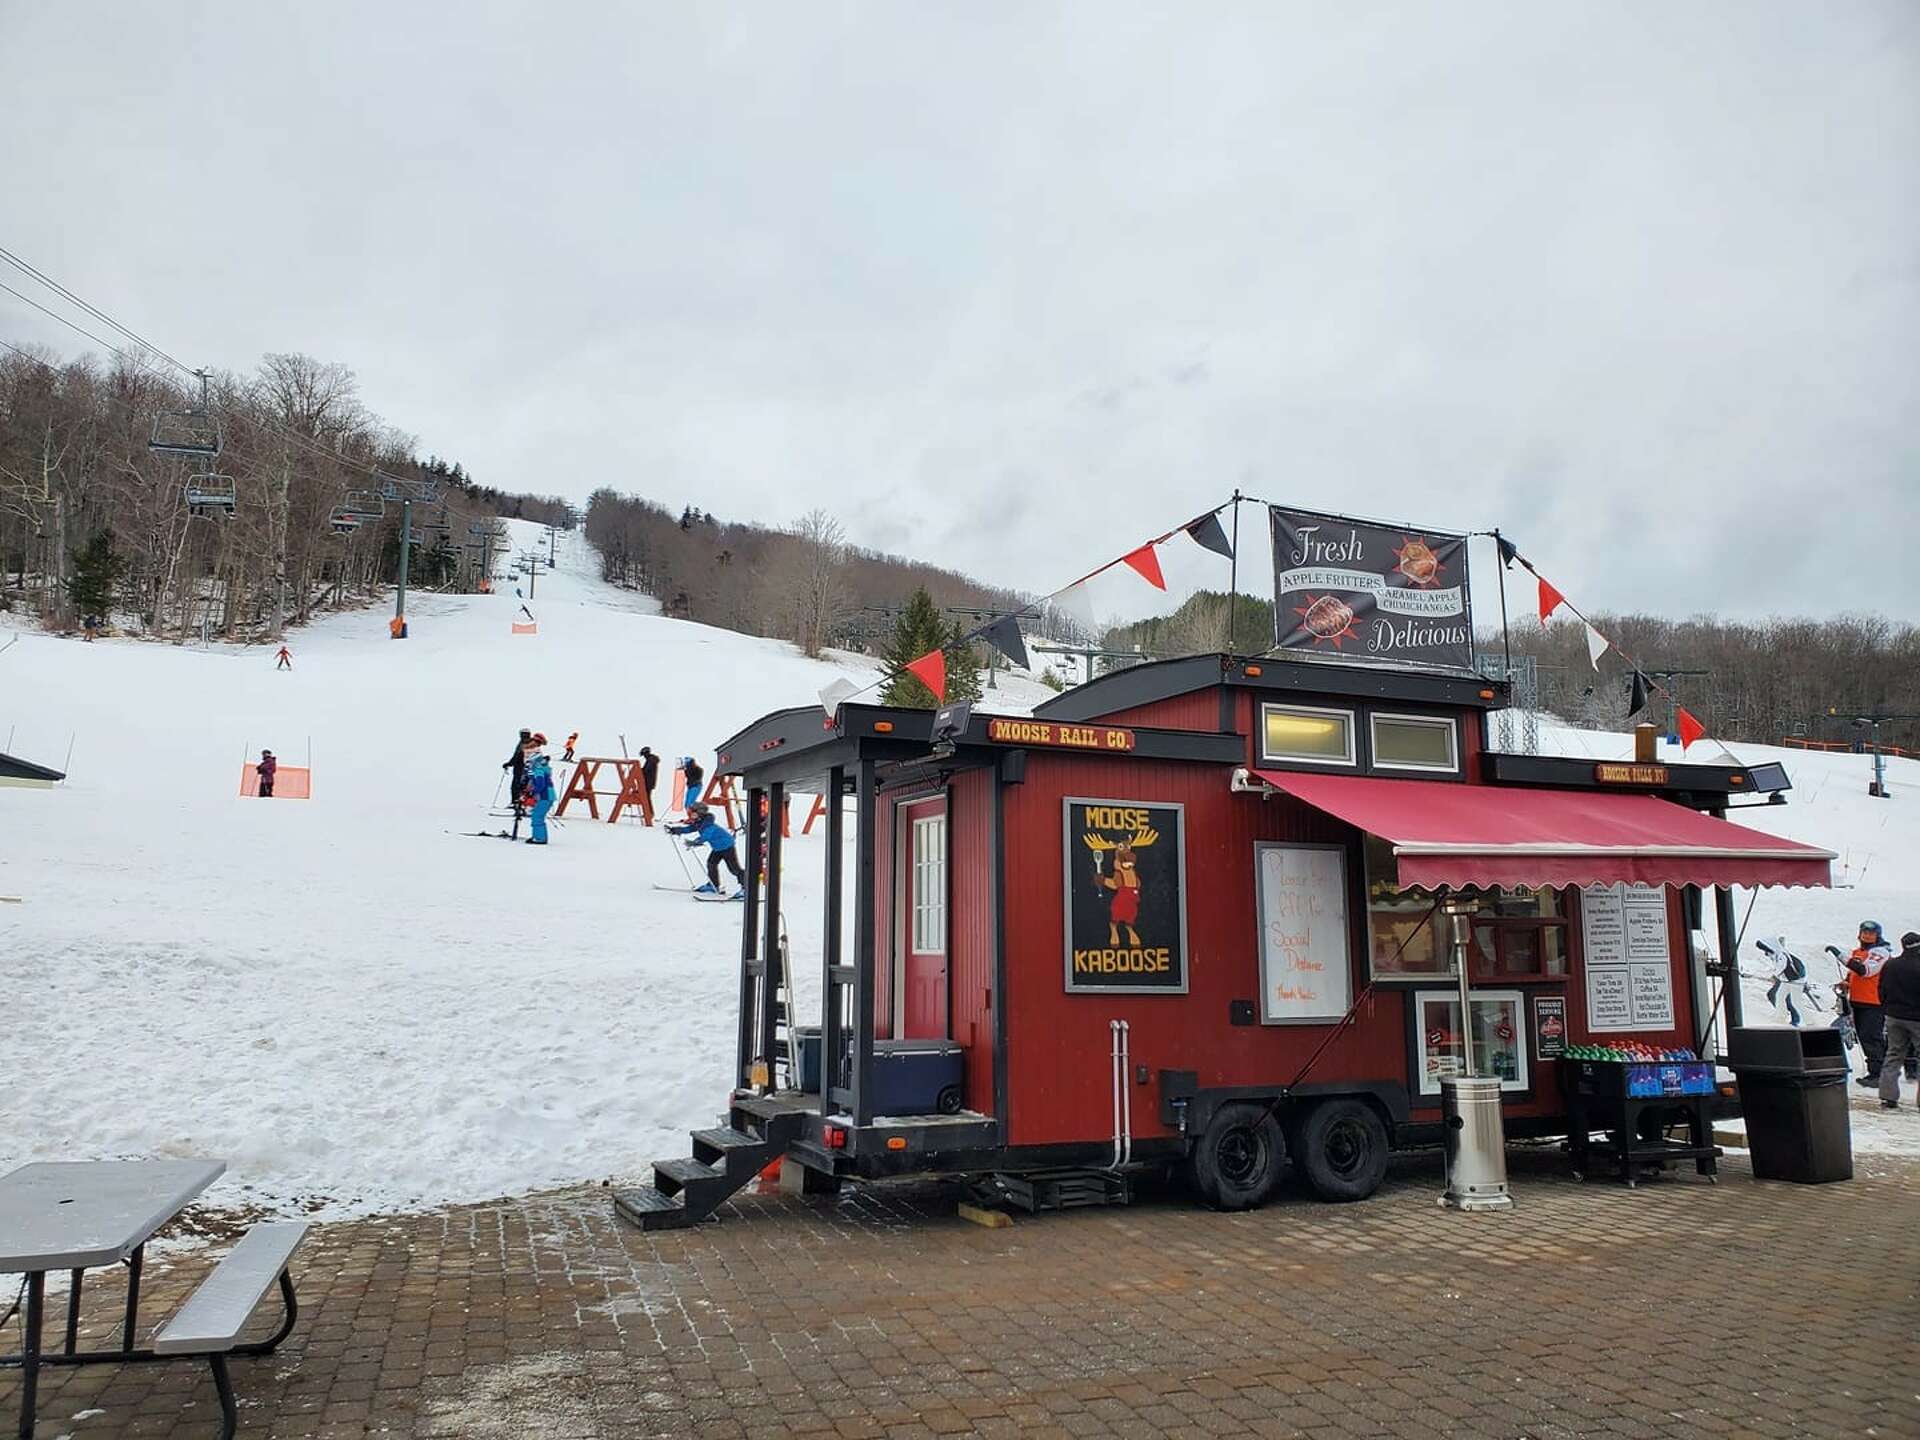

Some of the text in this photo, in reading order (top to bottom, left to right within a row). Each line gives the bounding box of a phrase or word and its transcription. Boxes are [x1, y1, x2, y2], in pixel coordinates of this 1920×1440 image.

[1291, 525, 1364, 566] Fresh
[1283, 572, 1382, 588] APPLE FRITTERS
[1376, 587, 1459, 602] CARAMEL APPLE
[1368, 618, 1467, 653] Delicious
[995, 720, 1131, 750] MOOSE RAIL CO.
[1085, 806, 1150, 831] MOOSE
[1270, 921, 1311, 948] Social
[1074, 948, 1170, 973] KABOOSE
